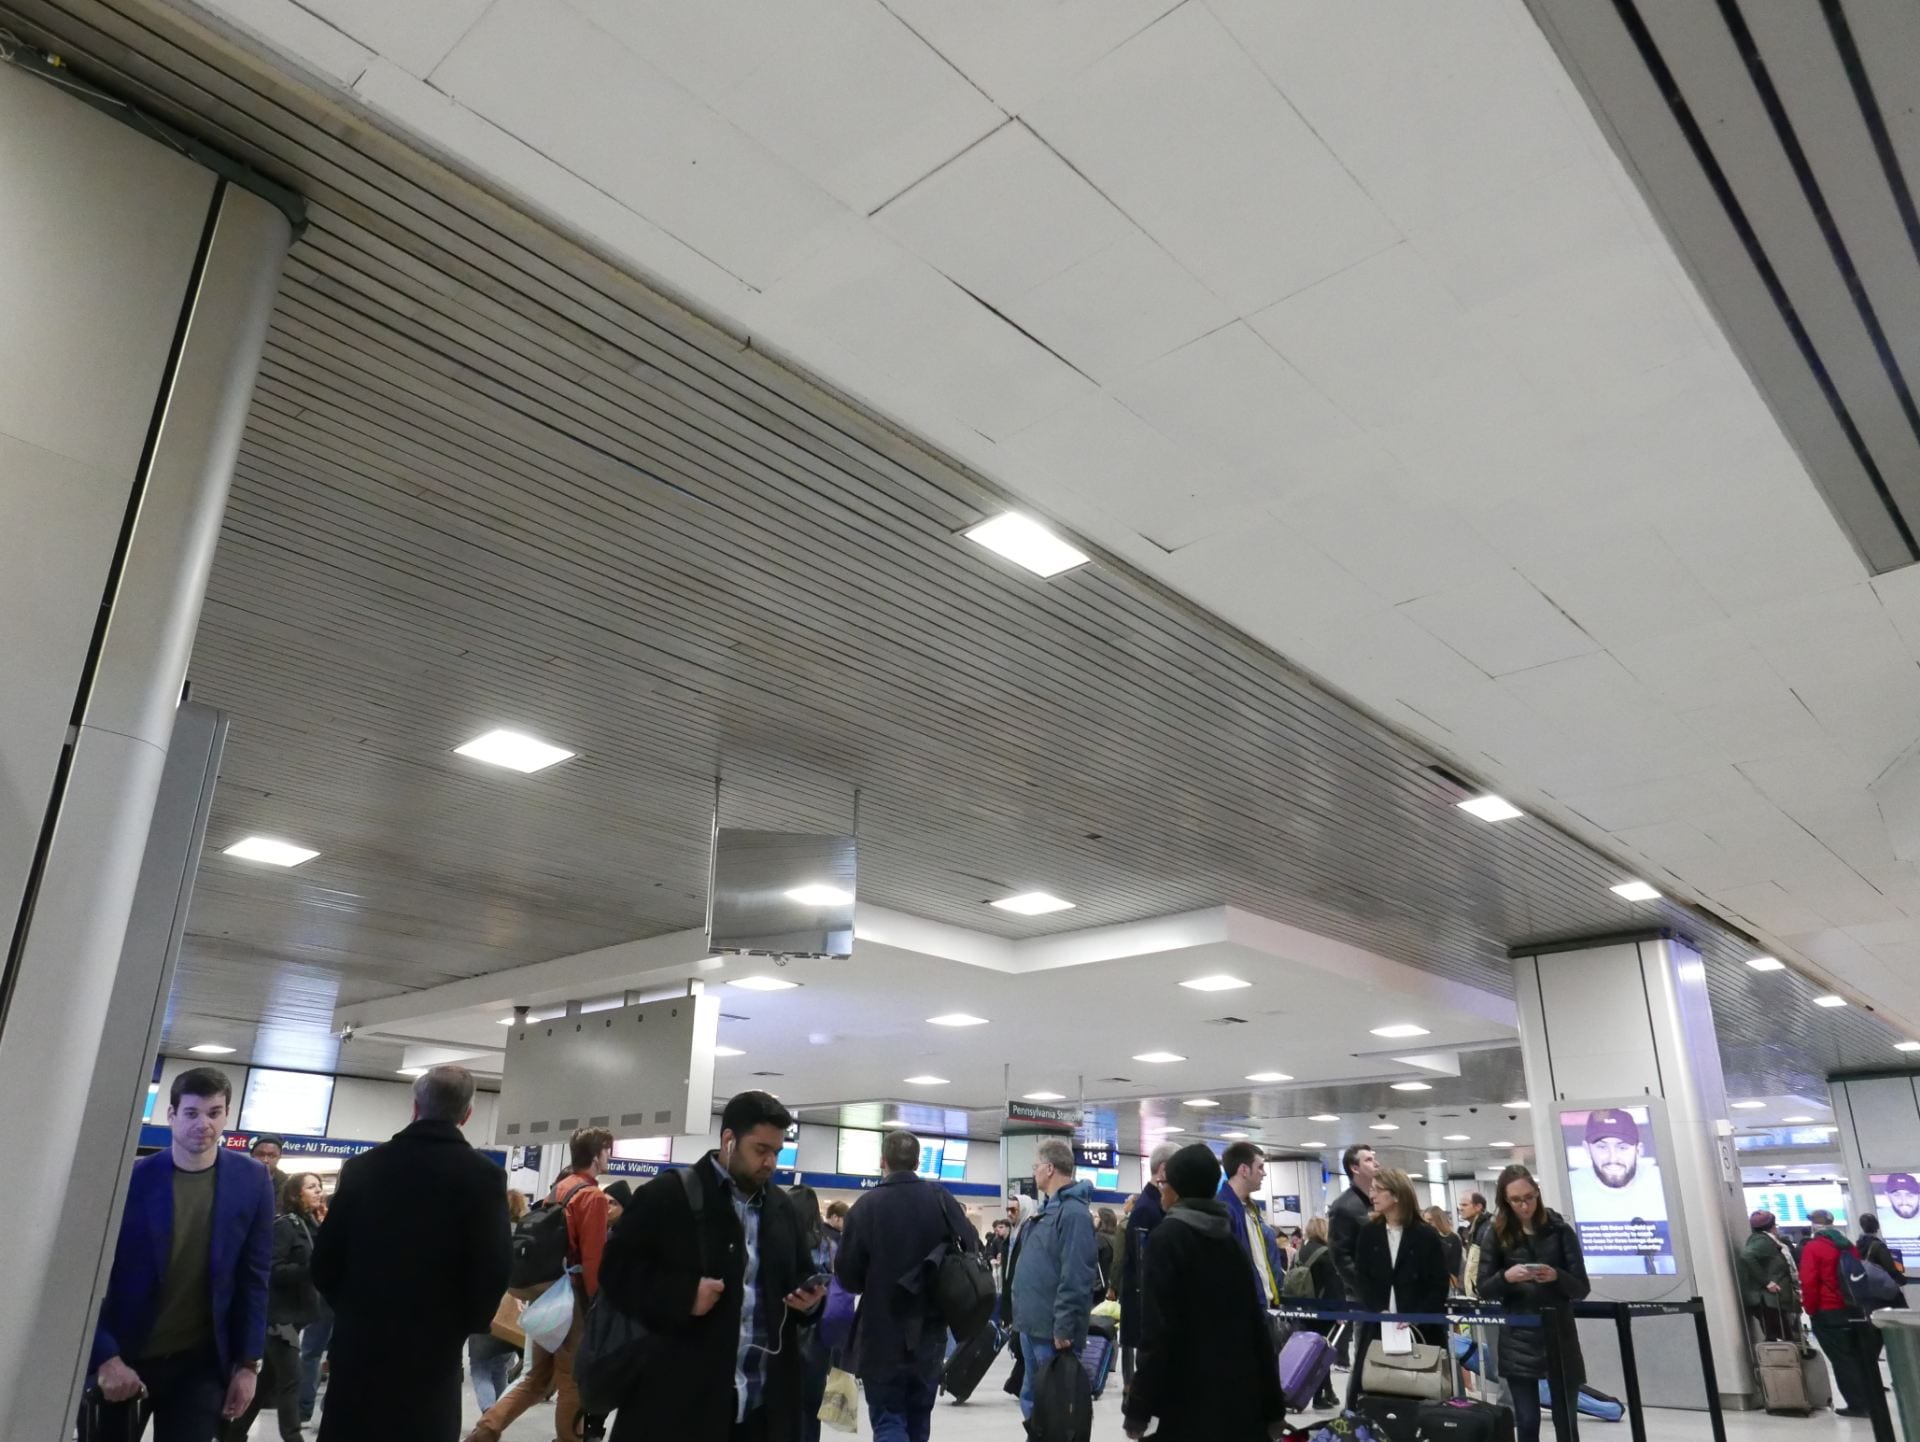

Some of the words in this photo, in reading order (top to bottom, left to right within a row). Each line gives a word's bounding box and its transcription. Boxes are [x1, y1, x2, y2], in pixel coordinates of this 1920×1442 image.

[1013, 1105, 1056, 1119] Pennsylvania
[226, 1137, 247, 1149] Exit
[282, 1141, 300, 1151] Ave
[305, 1142, 317, 1153] NJ
[320, 1143, 351, 1155] Transit
[628, 1163, 659, 1175] Waiting
[1280, 1311, 1319, 1319] AMTRAK
[1461, 1317, 1506, 1325] AMTRAK
